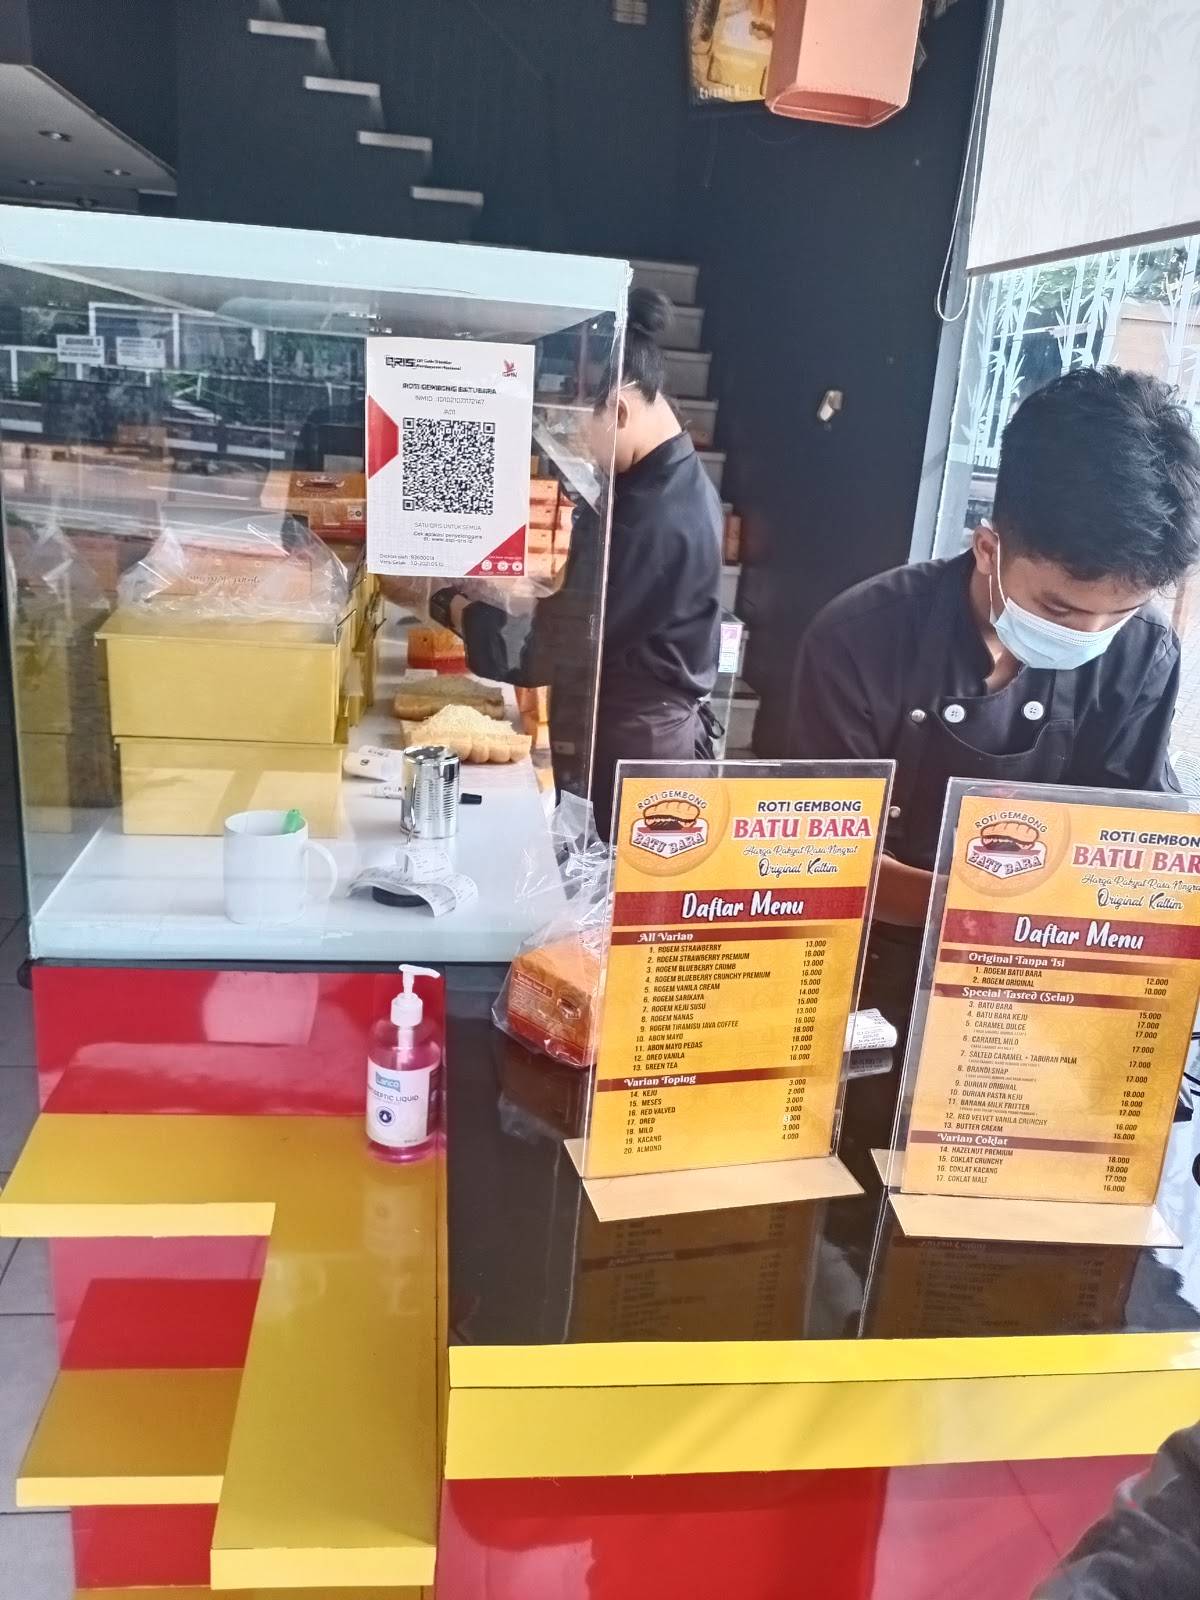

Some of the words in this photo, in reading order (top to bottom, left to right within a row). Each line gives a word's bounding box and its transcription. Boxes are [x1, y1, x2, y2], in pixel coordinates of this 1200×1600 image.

[385, 356, 416, 368] QRIS
[421, 384, 457, 392] GEMBONG
[638, 794, 658, 810] ROTI
[661, 790, 708, 810] GEMBONG
[757, 801, 790, 813] ROTI
[794, 801, 861, 812] GEMBONG
[734, 818, 799, 838] BATU
[808, 817, 872, 837] BARA
[975, 814, 997, 829] ROTI
[1000, 811, 1048, 833] GEMBONG
[633, 832, 668, 853] BATU
[670, 832, 704, 854] BARA
[1100, 830, 1135, 843] ROTI
[1138, 832, 1200, 847] GEMBON
[743, 845, 772, 856] Harga
[774, 845, 804, 856] Rakyat
[828, 845, 858, 856] Ningrat
[968, 851, 1001, 873] BATU
[1004, 855, 1042, 876] BARA
[1073, 845, 1144, 870] BATU
[1152, 851, 1200, 874] BAR
[759, 858, 801, 877] Original
[807, 858, 838, 874] Kaltim
[1081, 875, 1113, 886] Harga
[1114, 876, 1146, 890] Rakyat
[1172, 880, 1200, 893] Ningra
[1098, 888, 1143, 910] Original
[1149, 892, 1183, 910] Kaltim
[681, 892, 743, 922] Daftar
[750, 891, 804, 916] Menu
[637, 932, 656, 943] All
[657, 931, 694, 941] Varian
[1014, 916, 1080, 948] Daftar
[1086, 921, 1144, 950] Menu
[680, 944, 721, 952] STRAWBERRY
[806, 940, 827, 948] 13.000
[656, 955, 678, 963] ROGEM
[679, 954, 720, 962] STRAWBERRY
[721, 952, 750, 960] PREMIUM
[968, 952, 1013, 965] Original
[1014, 955, 1048, 968] Tanpa
[1051, 958, 1065, 967] Isi
[655, 965, 677, 973] ROGEM
[678, 963, 714, 972] BLUEBERRY
[654, 975, 676, 983] ROGEM
[677, 974, 712, 982] BLUEBERRY
[713, 972, 742, 980] CRUNCHY
[742, 971, 771, 979] PREMIUM
[983, 967, 1006, 976] ROGEM
[1007, 969, 1024, 977] BATU
[1025, 970, 1042, 978] BARA
[1146, 978, 1169, 986] 12.000
[653, 985, 675, 993] ROGEM
[698, 983, 720, 991] CREAM
[799, 988, 820, 996] 14.000
[981, 976, 1005, 985] ROGEM
[1005, 978, 1035, 987] ORIGINAL
[1144, 988, 1167, 996] 10.000
[962, 986, 1001, 997] Special
[1003, 989, 1038, 1000] Tasted
[1039, 992, 1075, 1004] (Selai)
[978, 1001, 995, 1010] BATU
[995, 1002, 1013, 1010] BARA
[1139, 1012, 1162, 1020] 15.000
[673, 1013, 694, 1021] NANAS
[976, 1011, 993, 1019] BATU
[994, 1012, 1011, 1020] BARA
[1012, 1013, 1028, 1021] KEJU
[1137, 1021, 1160, 1030] 17.000
[649, 1024, 671, 1032] ROGEM
[672, 1022, 701, 1030] TIRAMISU
[702, 1021, 716, 1029] JAVA
[974, 1021, 1004, 1030] CARAMEL
[1005, 1023, 1026, 1031] DULCE
[1135, 1031, 1158, 1039] 17.000
[648, 1034, 666, 1042] ABON
[666, 1033, 684, 1041] MAYO
[971, 1035, 1002, 1045] CARAMEL
[663, 1052, 685, 1060] VANILA
[969, 1050, 993, 1059] SALTED
[993, 1052, 1023, 1061] CARAMEL
[1030, 1054, 1059, 1063] TABURAN
[1060, 1056, 1078, 1065] PALM
[666, 1061, 678, 1069] TEA
[623, 1077, 659, 1087] Varian
[661, 1075, 697, 1085] Toping
[964, 1080, 987, 1089] DURIAN
[988, 1082, 1017, 1091] ORIGINAL
[642, 1089, 658, 1097] KEJU
[962, 1090, 986, 1098] DURIAN
[1007, 1093, 1023, 1101] KEJU
[641, 1098, 662, 1106] MESES
[960, 1098, 986, 1107] BANANA
[987, 1101, 1003, 1109] MILK
[1004, 1102, 1030, 1111] FRITTER
[640, 1108, 652, 1116] RED
[653, 1106, 676, 1115] VALVED
[971, 1114, 994, 1122] VELVET
[995, 1115, 1017, 1123] VANILA
[955, 1122, 980, 1131] BUTTER
[980, 1124, 1003, 1132] CREAM
[637, 1135, 662, 1143] KACANG
[937, 1133, 973, 1143] Varian
[974, 1135, 1009, 1146] Coklat
[637, 1145, 662, 1153] ALMOND
[952, 1146, 983, 1155] HAZELNUT
[984, 1148, 1014, 1156] PREMIUM
[950, 1155, 973, 1163] COKLAT
[974, 1157, 1004, 1165] CRUNCHY
[947, 1175, 971, 1183] COKLAT
[972, 1176, 988, 1184] MALT
[949, 1165, 972, 1173] COKLAT
[973, 1166, 998, 1174] KACANG
[1105, 1175, 1127, 1183] 17.000
